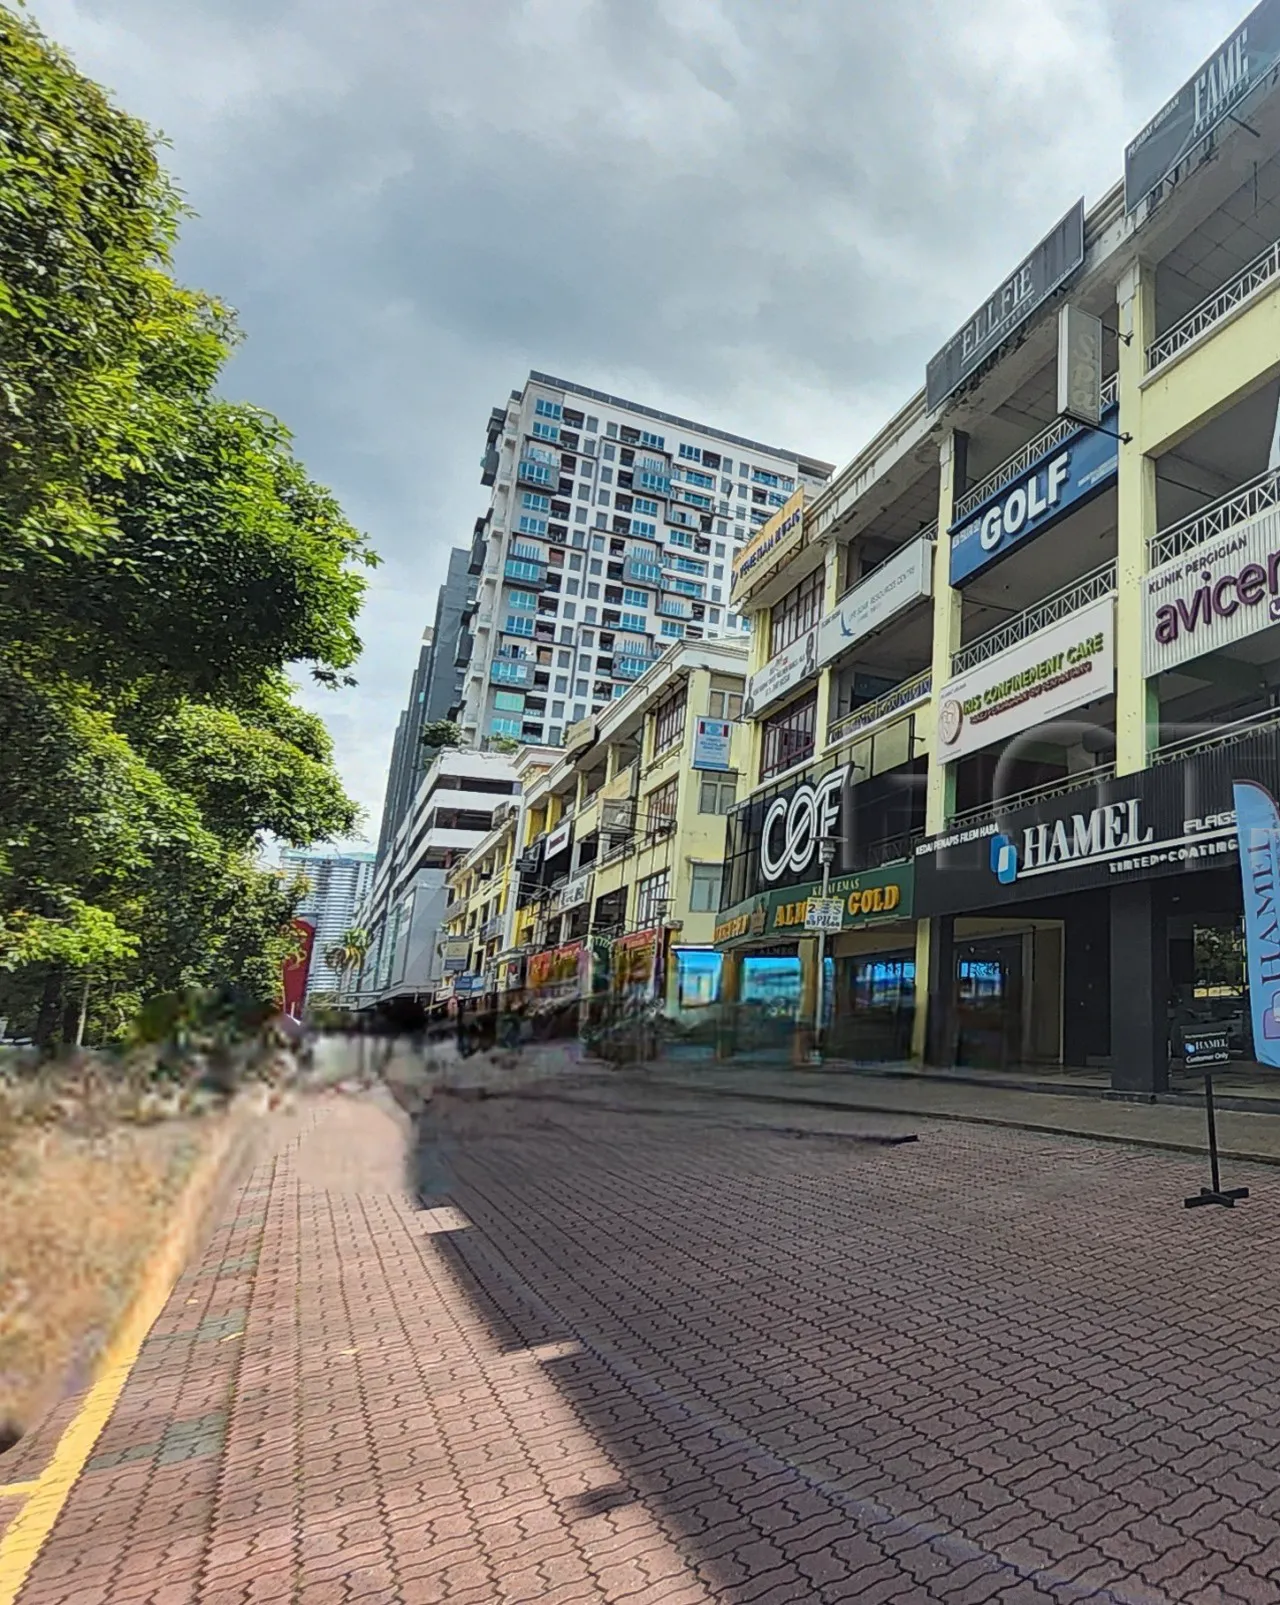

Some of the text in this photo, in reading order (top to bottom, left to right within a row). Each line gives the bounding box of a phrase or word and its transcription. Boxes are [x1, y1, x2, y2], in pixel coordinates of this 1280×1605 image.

[1193, 27, 1250, 126] FAME
[980, 451, 1069, 550] GOLF
[1149, 534, 1248, 595] KLINIK PERGIGIAN
[1066, 631, 1104, 664] CARE
[1022, 798, 1152, 870] HAMEL
[848, 885, 900, 916] GOLD
[1214, 1052, 1229, 1060] Only
